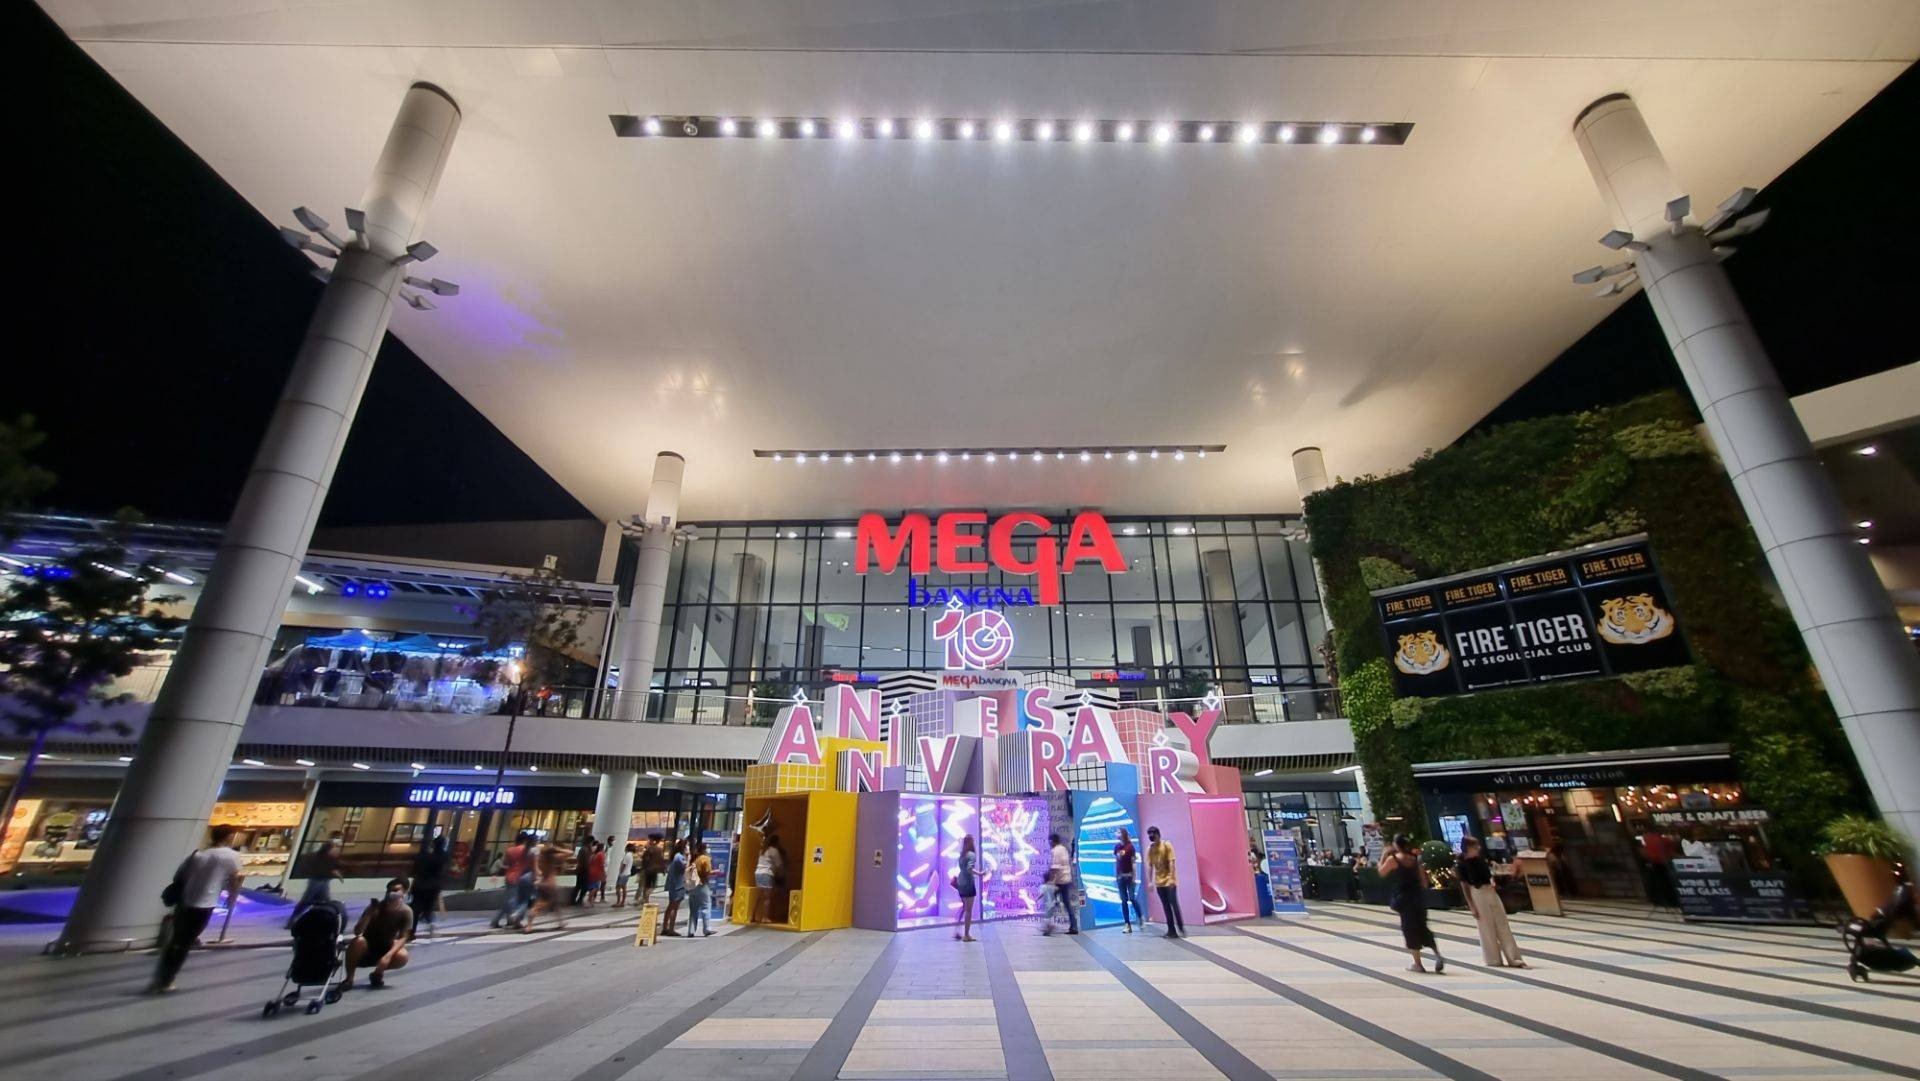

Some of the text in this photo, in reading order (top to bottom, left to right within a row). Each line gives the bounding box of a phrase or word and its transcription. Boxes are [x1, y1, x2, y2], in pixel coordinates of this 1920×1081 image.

[855, 511, 1128, 607] MEGA
[1582, 560, 1608, 575] FIRE
[1610, 552, 1644, 569] TIGER
[1510, 574, 1534, 589] FIRE
[1534, 568, 1566, 583] TIGER
[1445, 588, 1466, 601] FIRE
[1467, 582, 1495, 596] TIGER
[1386, 602, 1405, 613] FIRE
[1407, 595, 1432, 609] TIGER
[933, 609, 1014, 669] 10
[1455, 613, 1588, 657] FIRE TIGER
[1463, 657, 1477, 668] BY
[1558, 642, 1592, 655] CLUB
[1494, 768, 1626, 784] wine connection
[409, 789, 434, 802] au
[436, 786, 471, 803] bon
[1652, 812, 1683, 822] WINE
[1697, 811, 1736, 822] DRAFT
[1738, 809, 1769, 820] BEER
